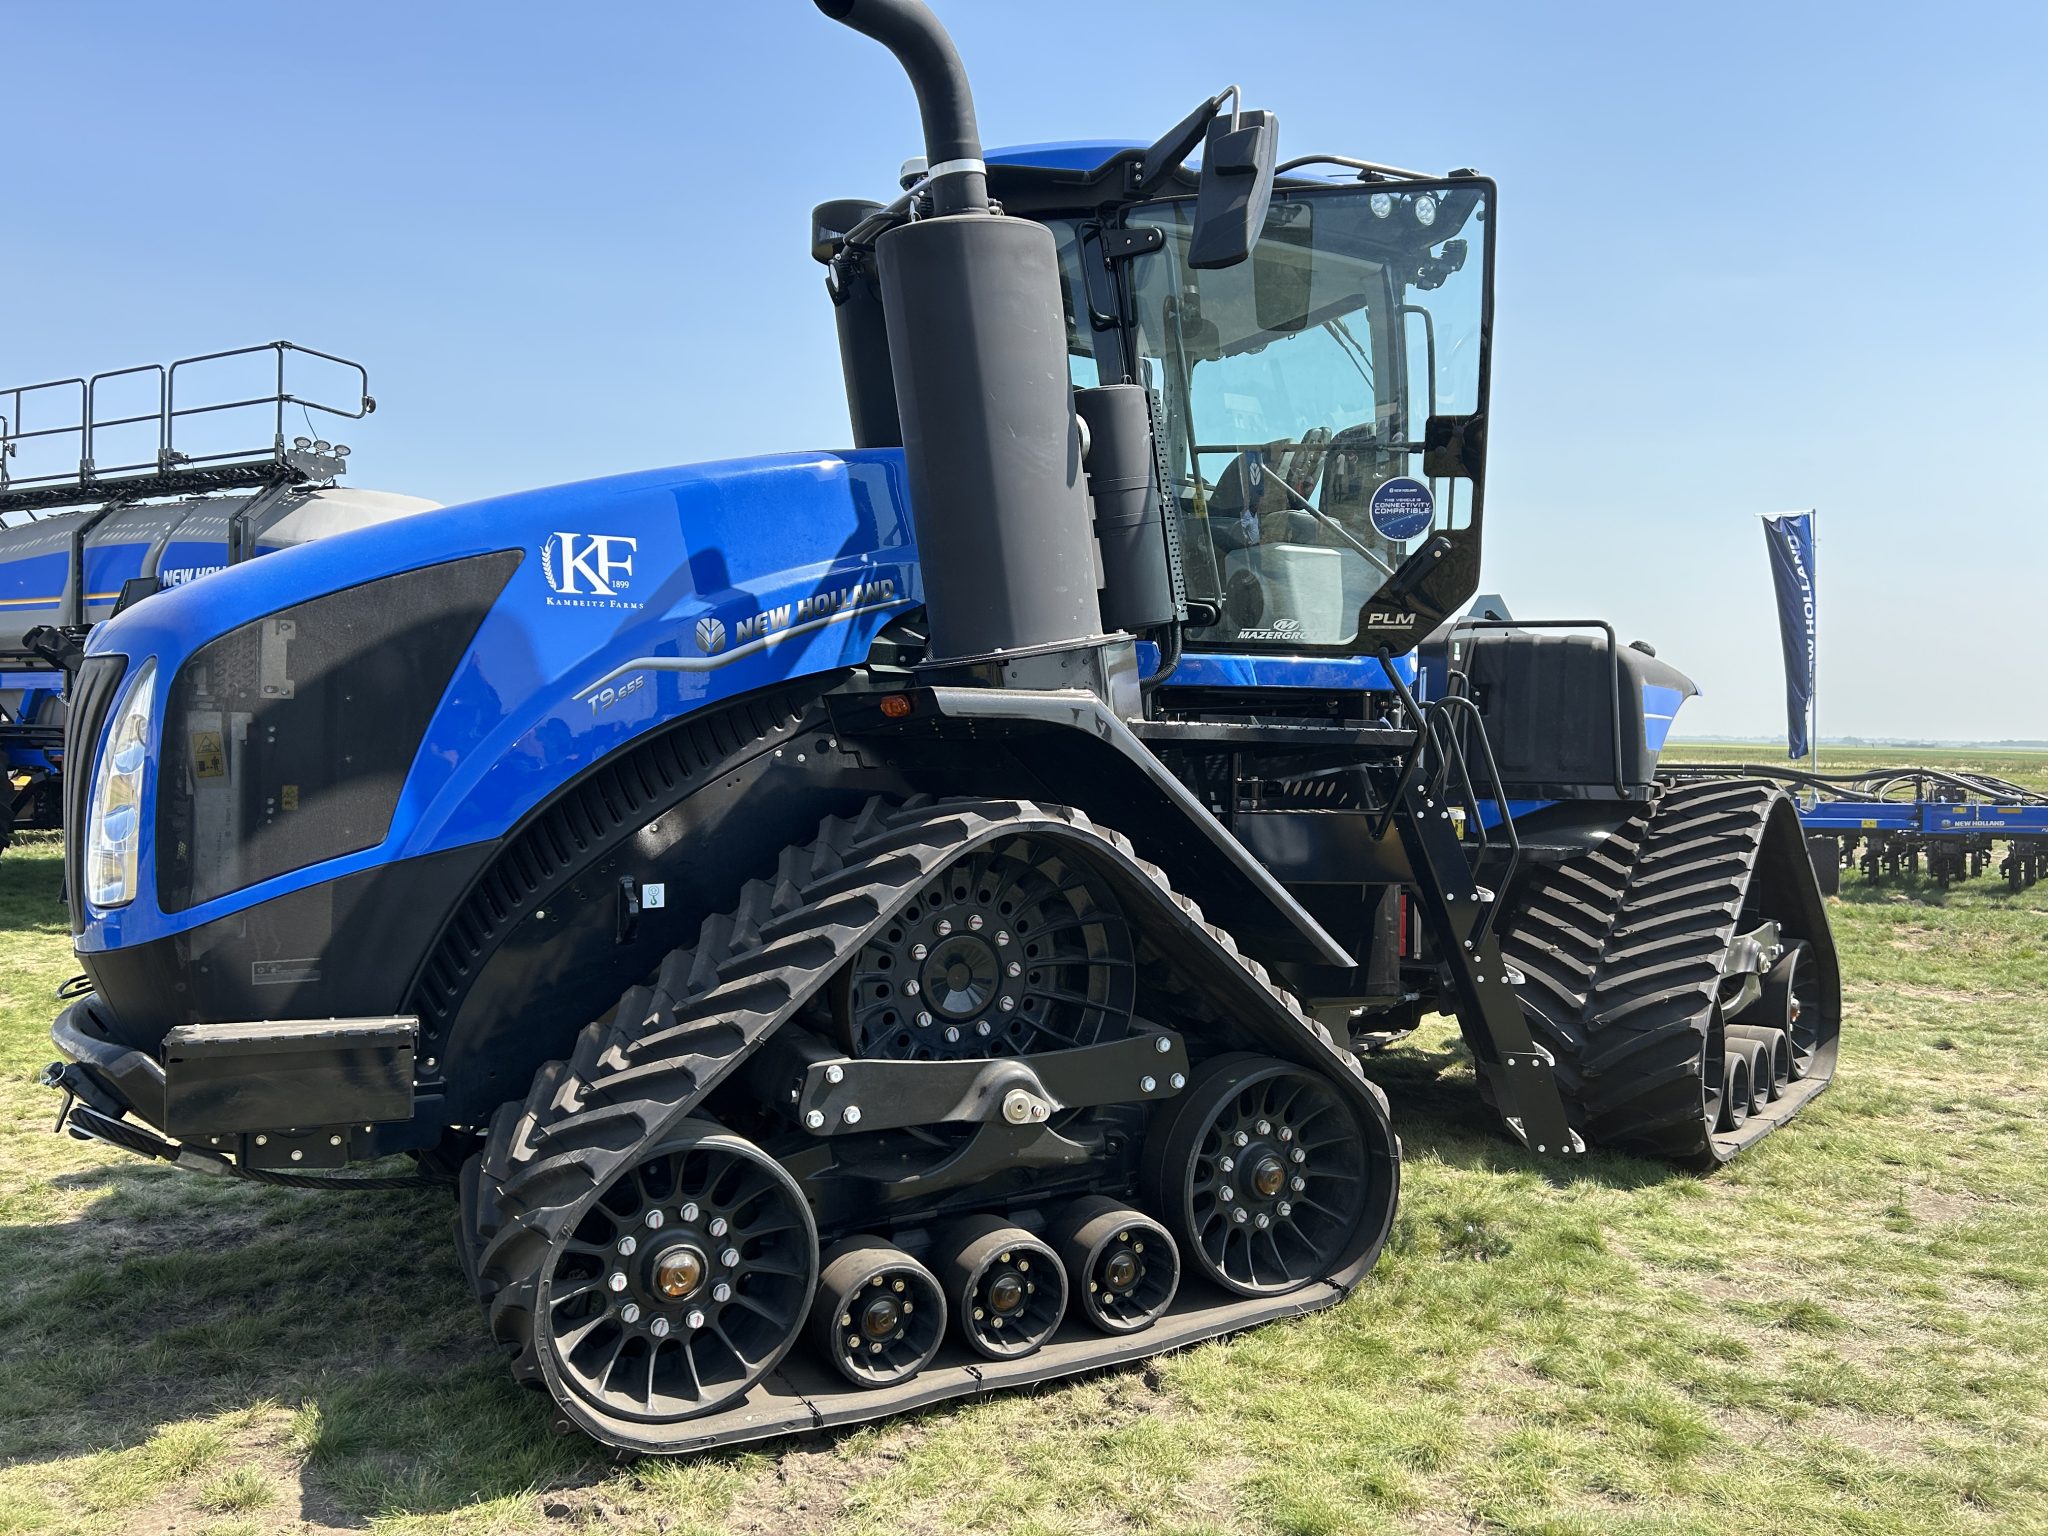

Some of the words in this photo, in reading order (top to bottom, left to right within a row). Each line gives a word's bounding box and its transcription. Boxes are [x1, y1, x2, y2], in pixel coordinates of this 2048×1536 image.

[163, 568, 194, 588] NEW
[552, 531, 637, 596] KF
[612, 580, 630, 589] 1899
[1787, 535, 1815, 635] HOLLAND
[736, 604, 791, 643] NEW
[797, 578, 894, 621] HOLLAND
[1368, 613, 1416, 624] PLM
[587, 675, 644, 717] T9.655
